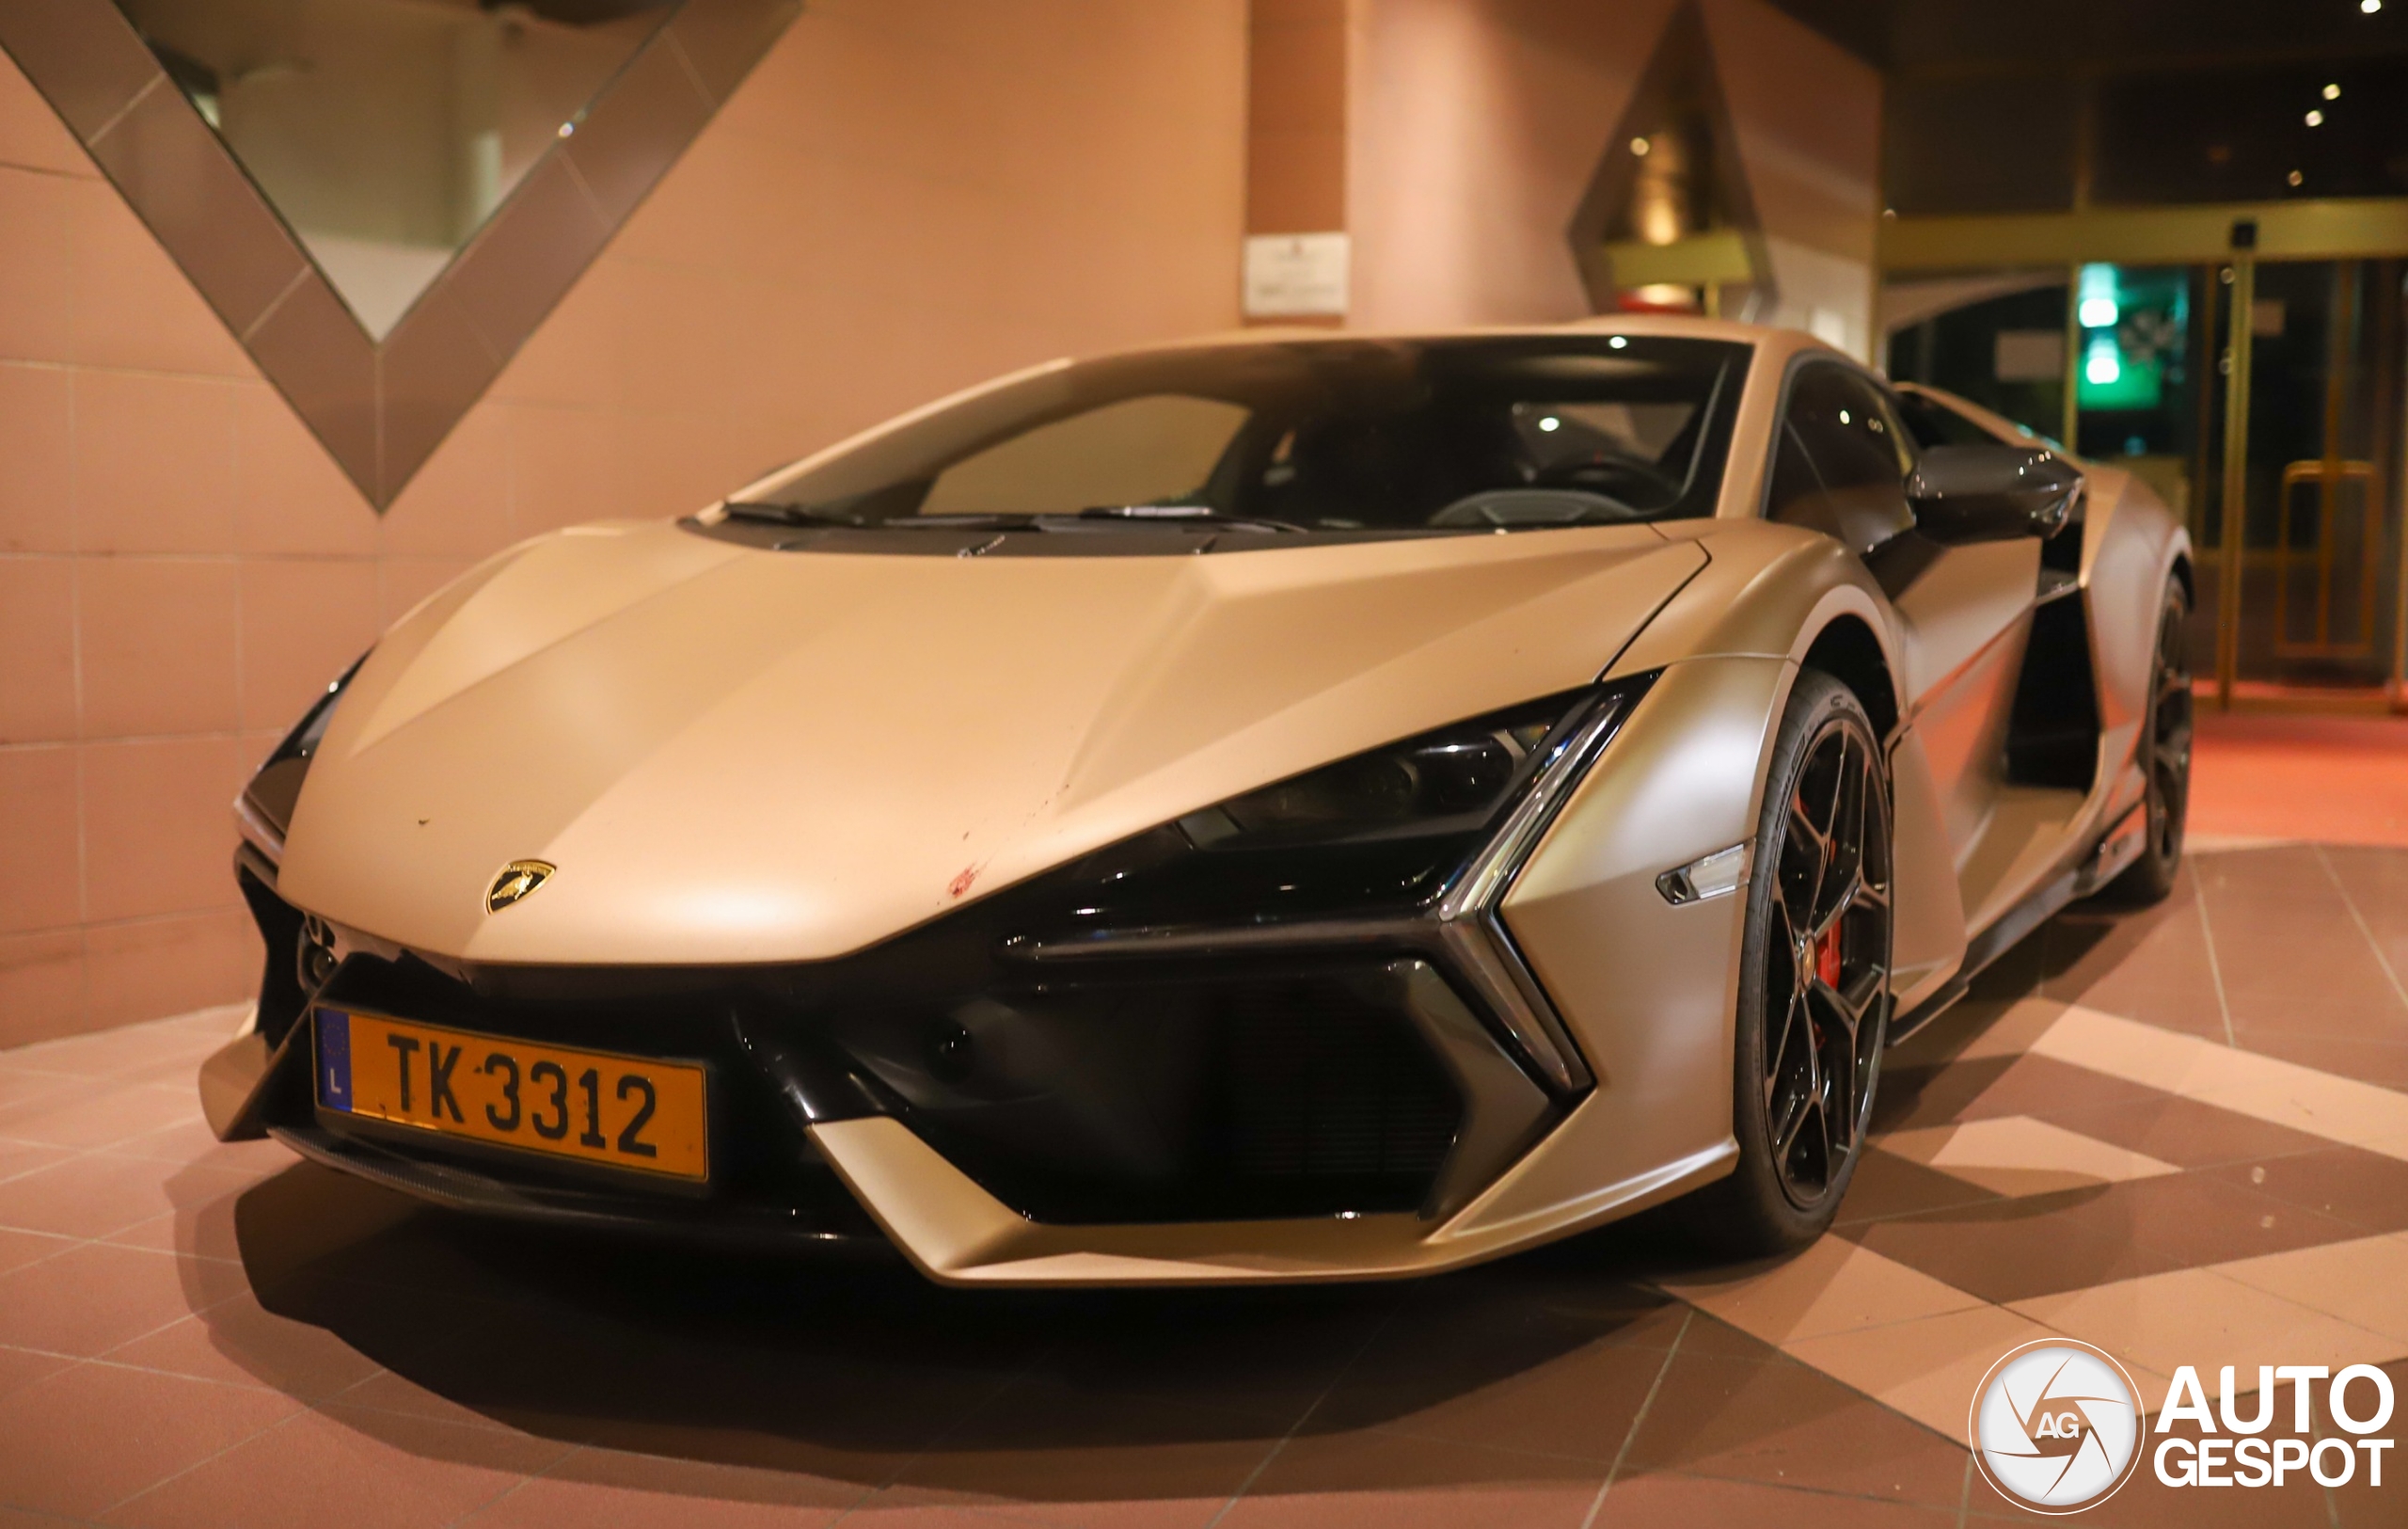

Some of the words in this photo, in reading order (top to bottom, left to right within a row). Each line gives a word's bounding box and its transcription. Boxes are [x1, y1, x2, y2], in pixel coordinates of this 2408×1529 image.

[329, 1067, 341, 1094] L
[387, 1032, 465, 1124] TK
[484, 1052, 658, 1158] 3312
